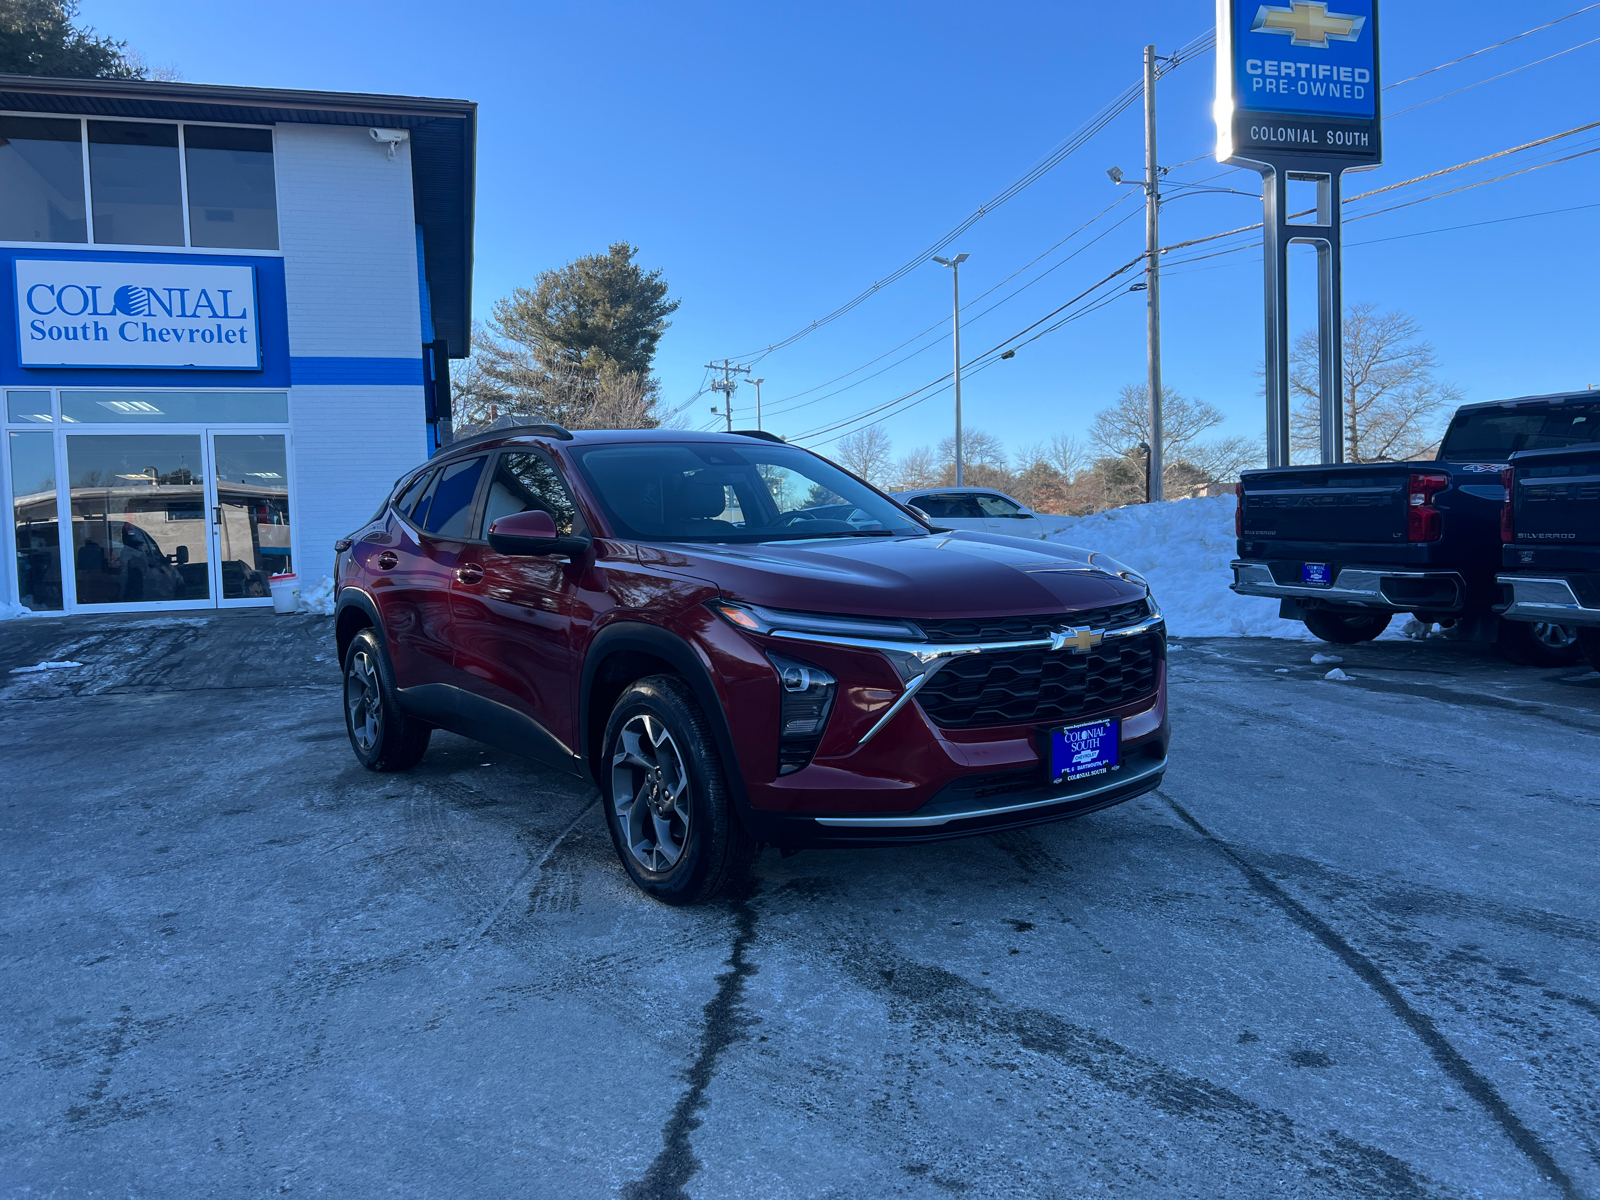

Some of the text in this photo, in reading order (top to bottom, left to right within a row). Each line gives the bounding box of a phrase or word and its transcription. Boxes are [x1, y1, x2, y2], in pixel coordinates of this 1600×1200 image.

[1246, 59, 1370, 83] CERTIFIED
[1253, 77, 1365, 99] PRE-OWNED
[1250, 125, 1369, 147] COLONIAL SOUTH
[26, 283, 247, 319] COLONIAL
[29, 319, 248, 344] South Chevrolet
[1064, 726, 1106, 743] COLONIAL
[1071, 737, 1100, 752] SOUTH
[1074, 751, 1097, 761] CHEVROLET
[1067, 767, 1107, 781] COLONIAL SOUTH
